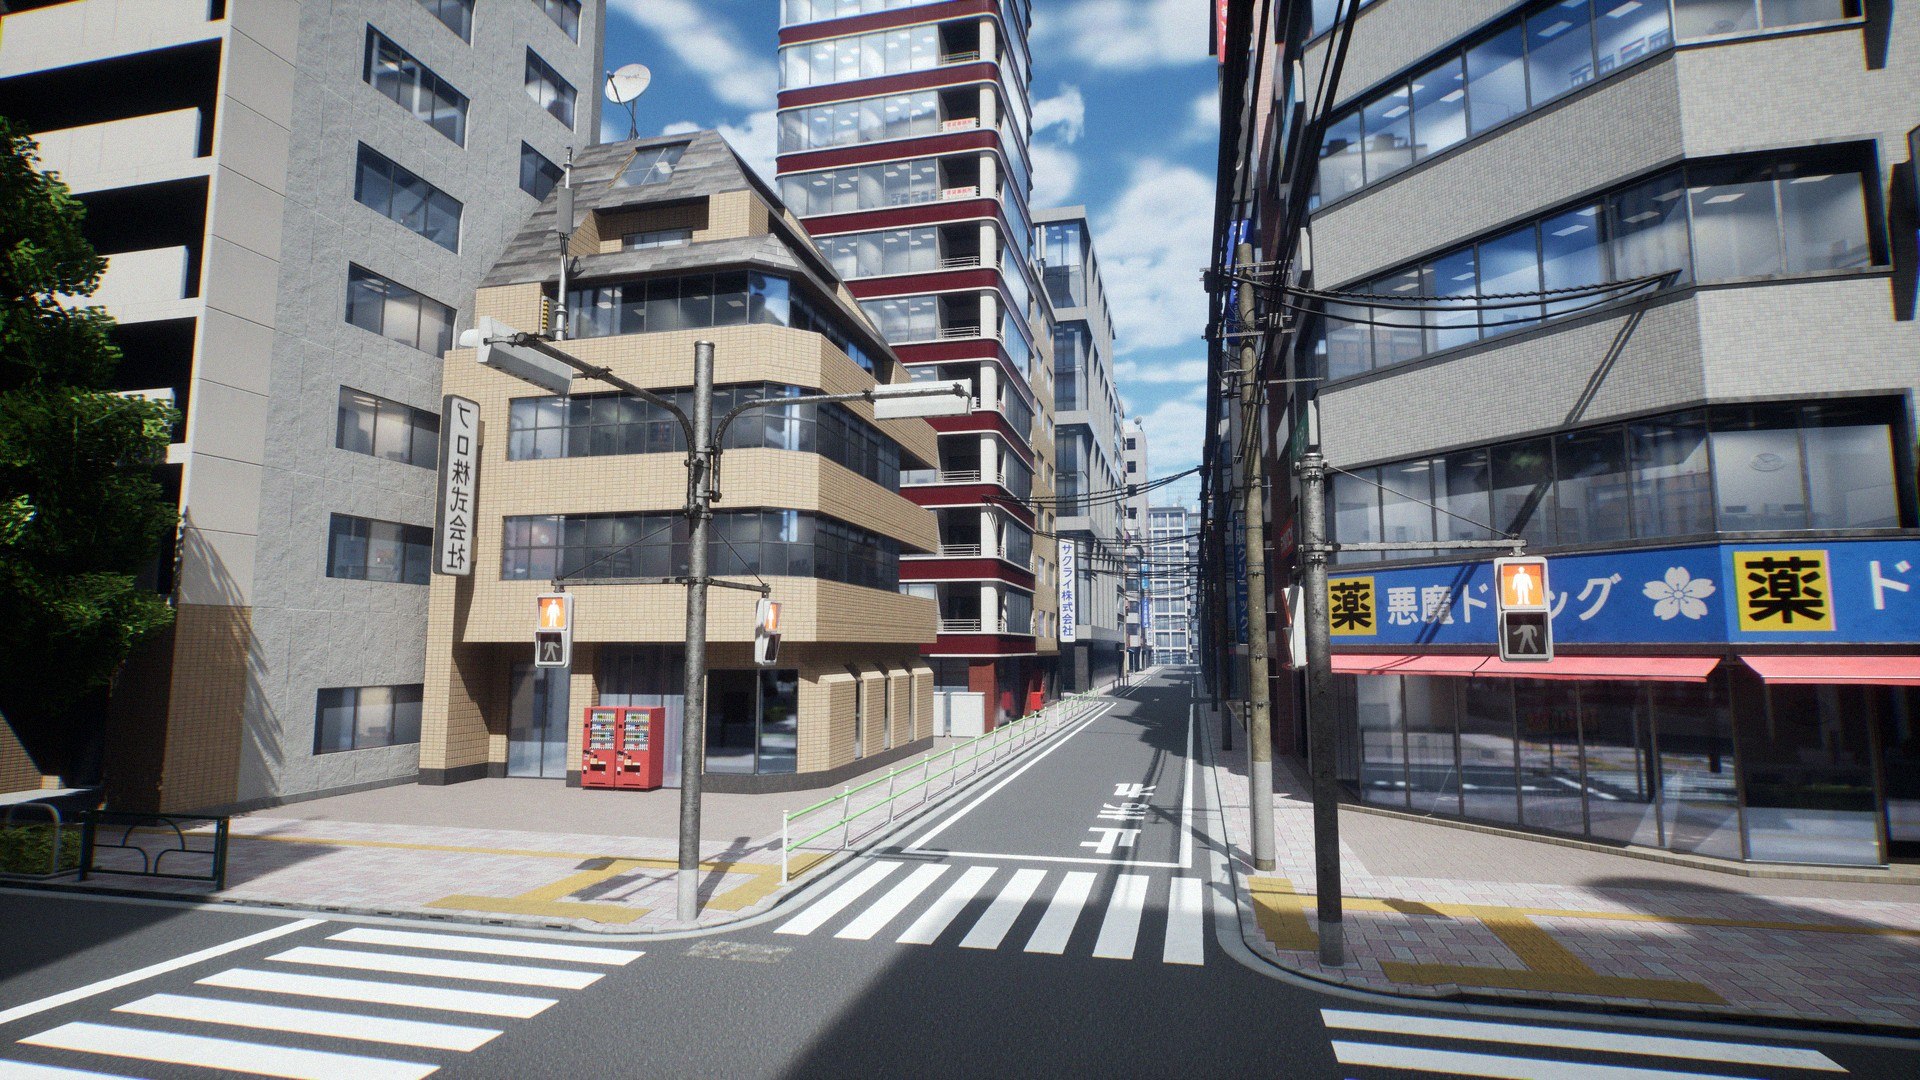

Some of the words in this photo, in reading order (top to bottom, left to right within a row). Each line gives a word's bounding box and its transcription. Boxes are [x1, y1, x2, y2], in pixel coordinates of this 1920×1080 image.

[1061, 544, 1074, 637] サクライ株式会社
[1330, 581, 1372, 630] 薬
[1387, 572, 1623, 626] 悪魔ドッグ
[1745, 556, 1826, 624] 薬
[1080, 783, 1157, 854] 止まれ
